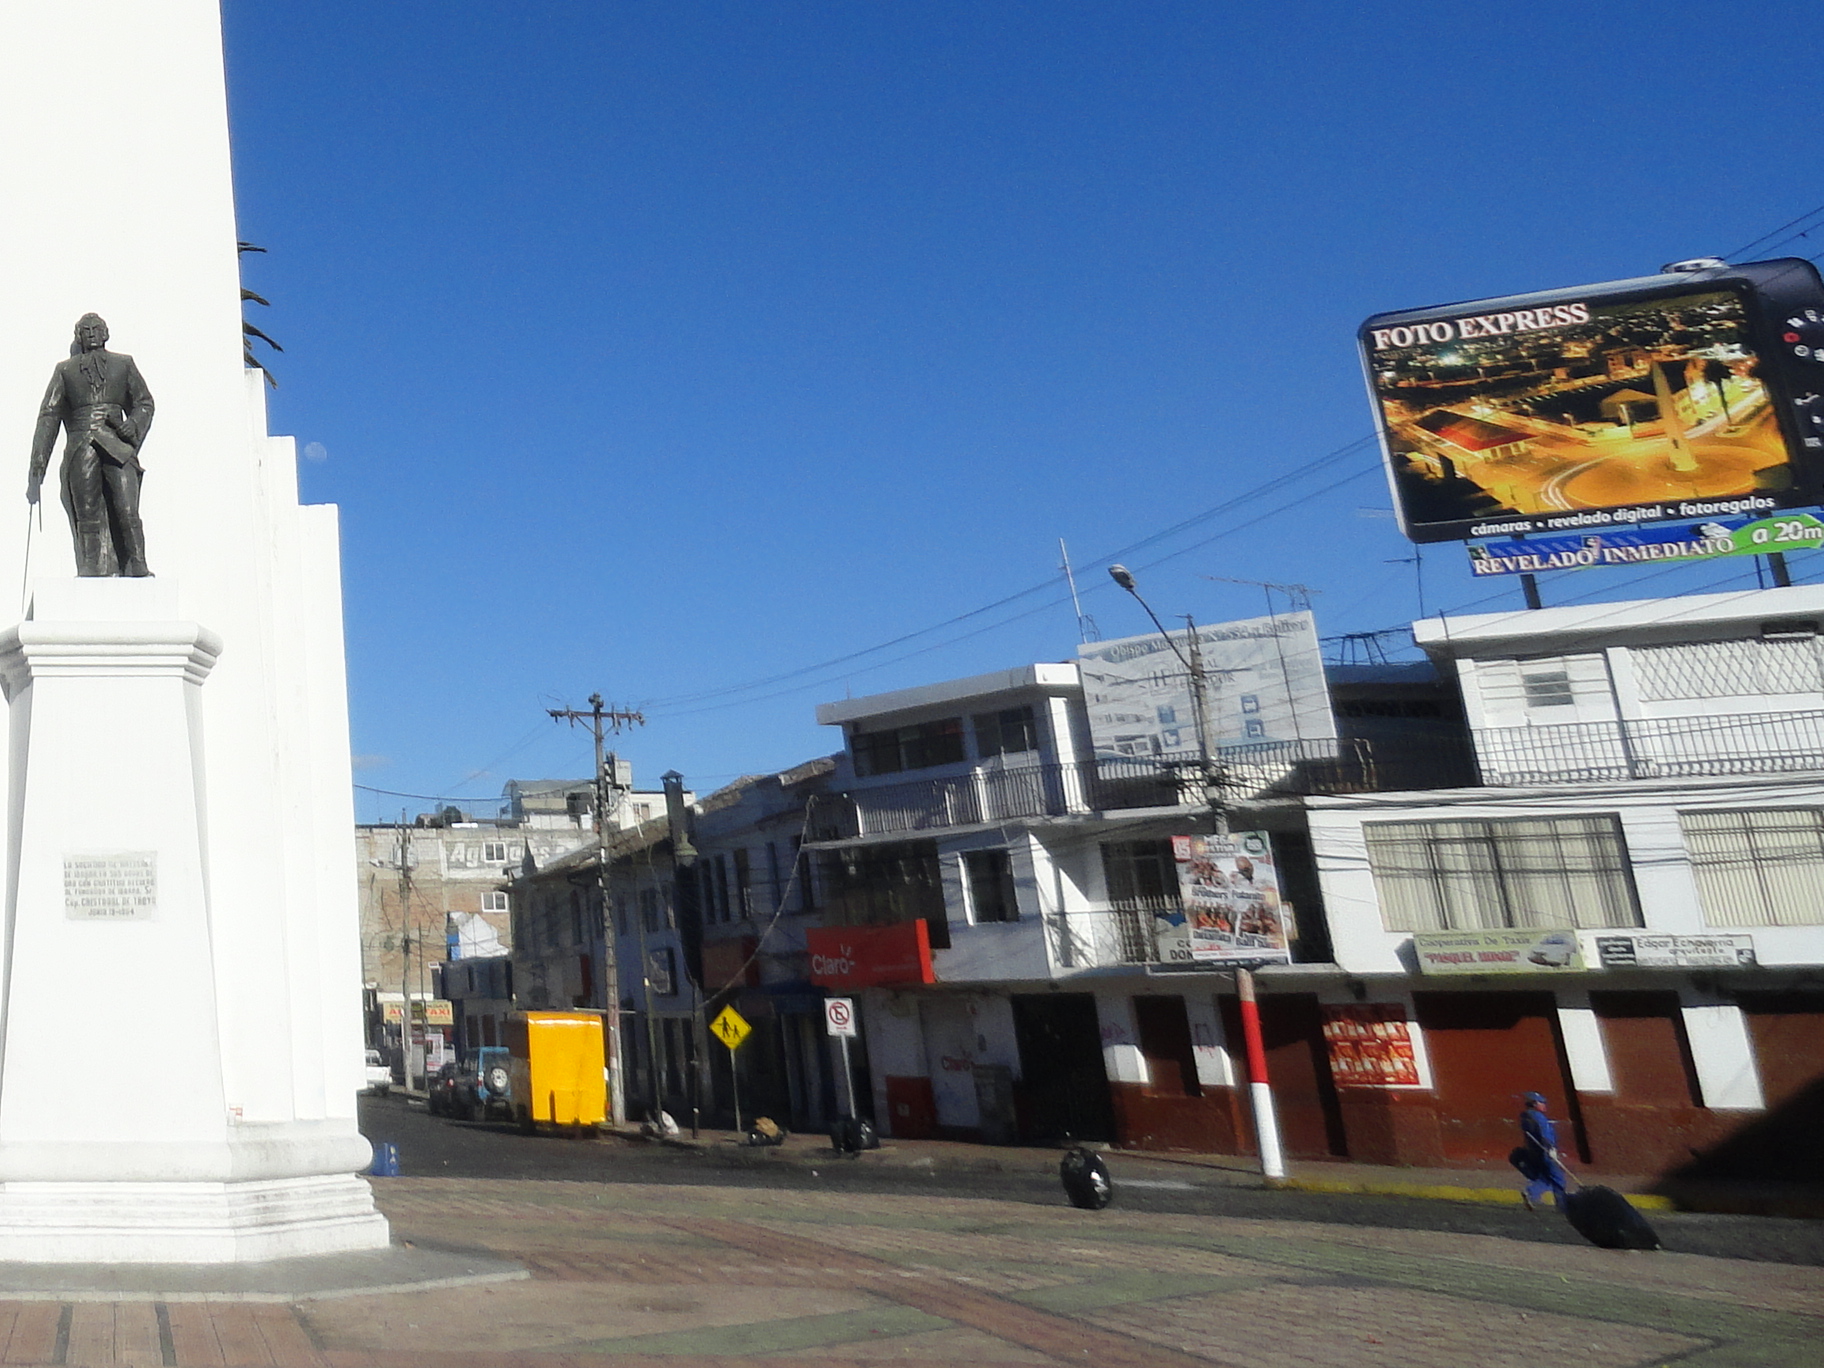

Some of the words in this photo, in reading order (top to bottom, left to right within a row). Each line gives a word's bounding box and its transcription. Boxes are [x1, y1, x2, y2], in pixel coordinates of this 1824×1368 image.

[1371, 322, 1453, 351] FOTO
[1455, 303, 1590, 339] EXPRESS
[1471, 519, 1532, 537] cámaras
[1547, 511, 1611, 529] revelado
[1613, 505, 1662, 526] digital
[1679, 495, 1776, 517] fotoregalos
[1752, 528, 1768, 544] a
[1473, 547, 1596, 575] REVELADO
[1603, 536, 1736, 564] INMEDIATO
[1419, 937, 1480, 948] Cooperativa
[1637, 938, 1670, 949] Edgar
[812, 953, 849, 974] Claro
